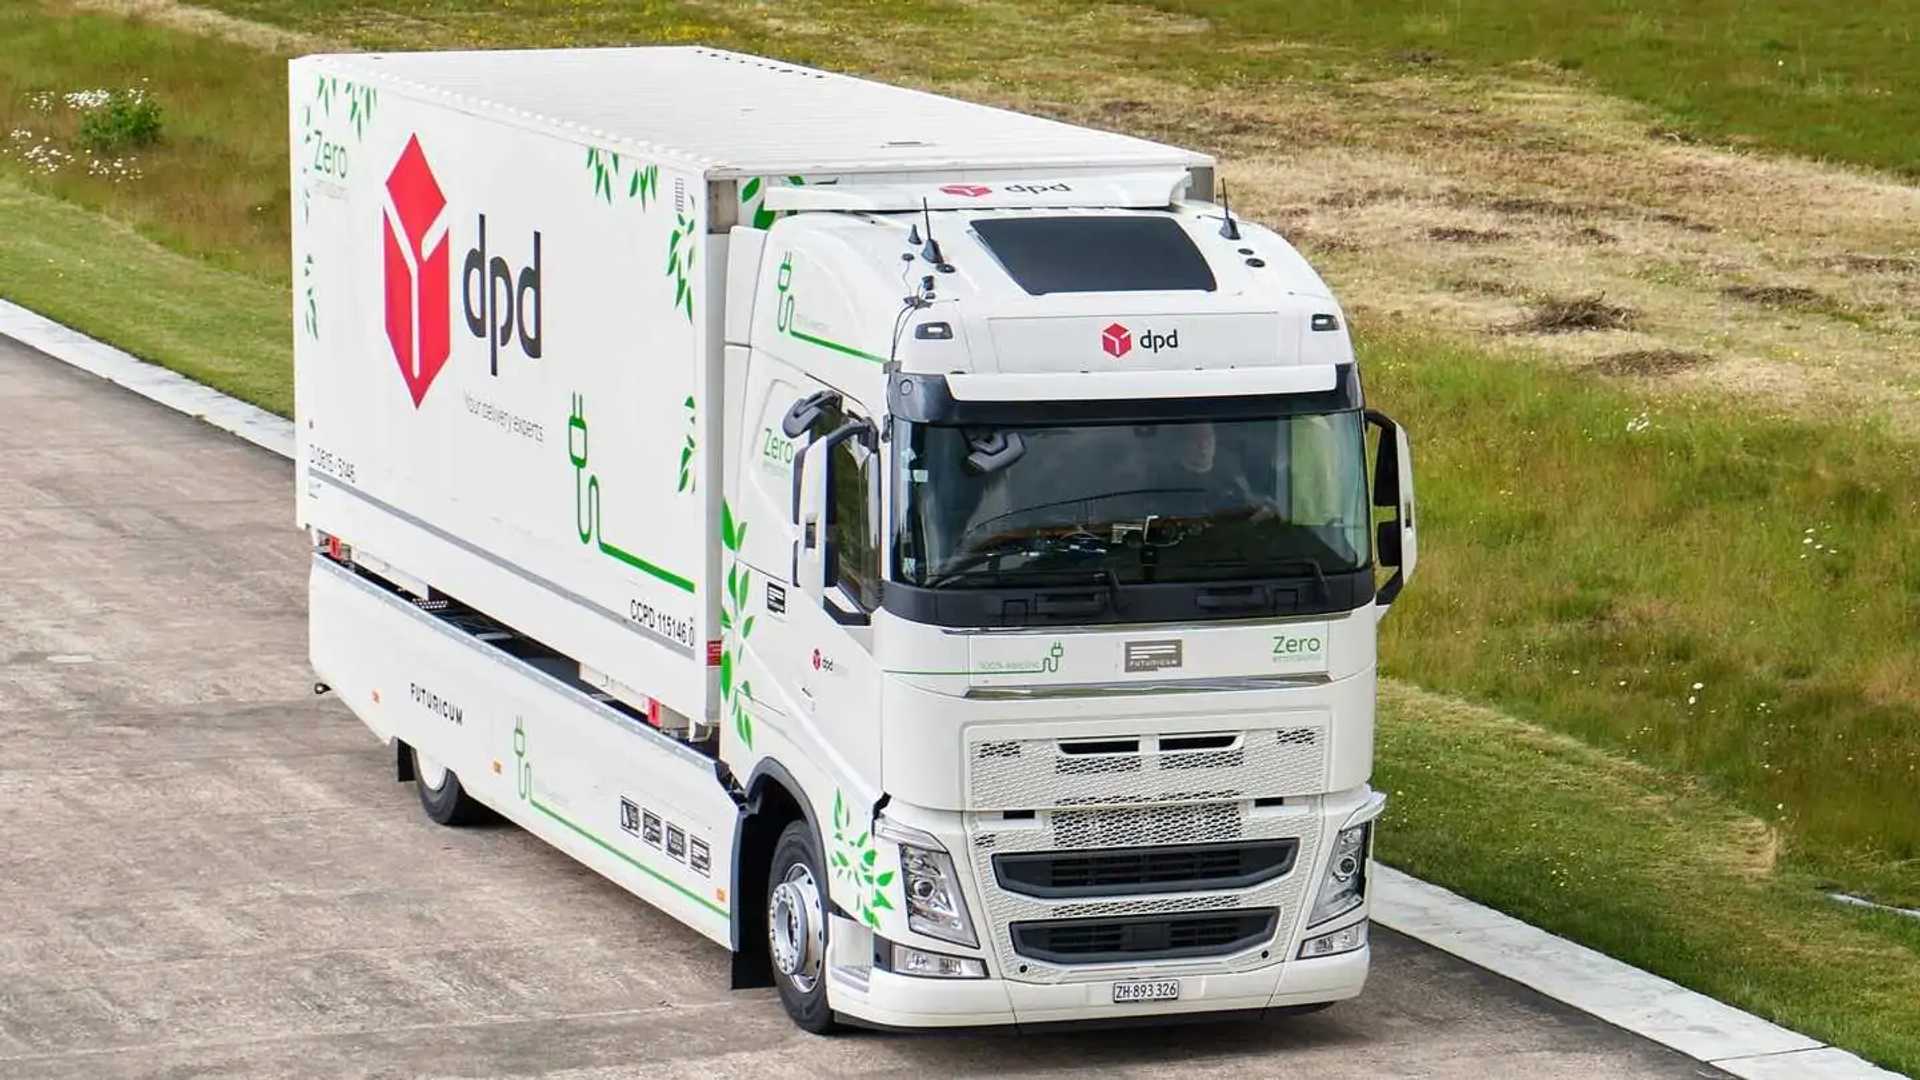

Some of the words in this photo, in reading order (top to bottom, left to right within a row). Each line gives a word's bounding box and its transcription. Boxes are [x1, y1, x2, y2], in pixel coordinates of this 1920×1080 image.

[314, 129, 348, 178] Zero
[1004, 183, 1071, 194] dpd
[463, 213, 542, 377] dpd
[1140, 328, 1178, 353] dpd
[763, 427, 794, 463] Zero
[631, 599, 656, 628] CCPD
[658, 612, 688, 644] 115146
[1273, 635, 1321, 653] Zero
[410, 682, 463, 727] FUTURICUM
[1156, 983, 1176, 997] 326
